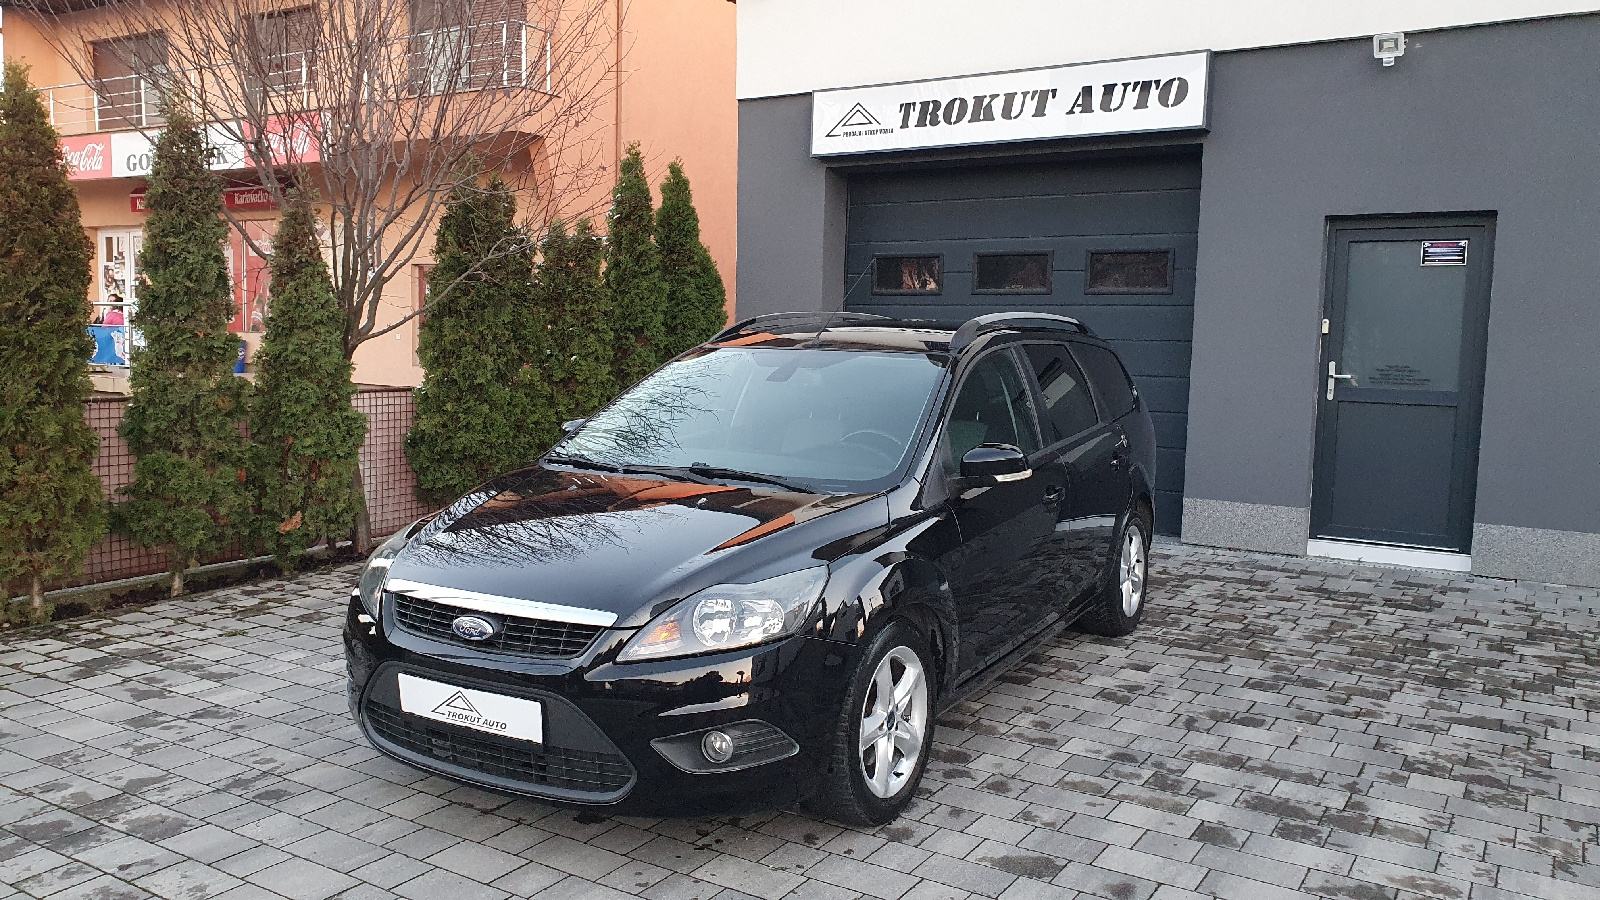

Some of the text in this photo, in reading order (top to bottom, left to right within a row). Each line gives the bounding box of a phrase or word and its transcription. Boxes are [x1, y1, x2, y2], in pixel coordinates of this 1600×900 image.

[899, 76, 1190, 130] TROKUT AUTO
[459, 621, 482, 636] Ford
[447, 710, 507, 730] TROKUT AUTO
